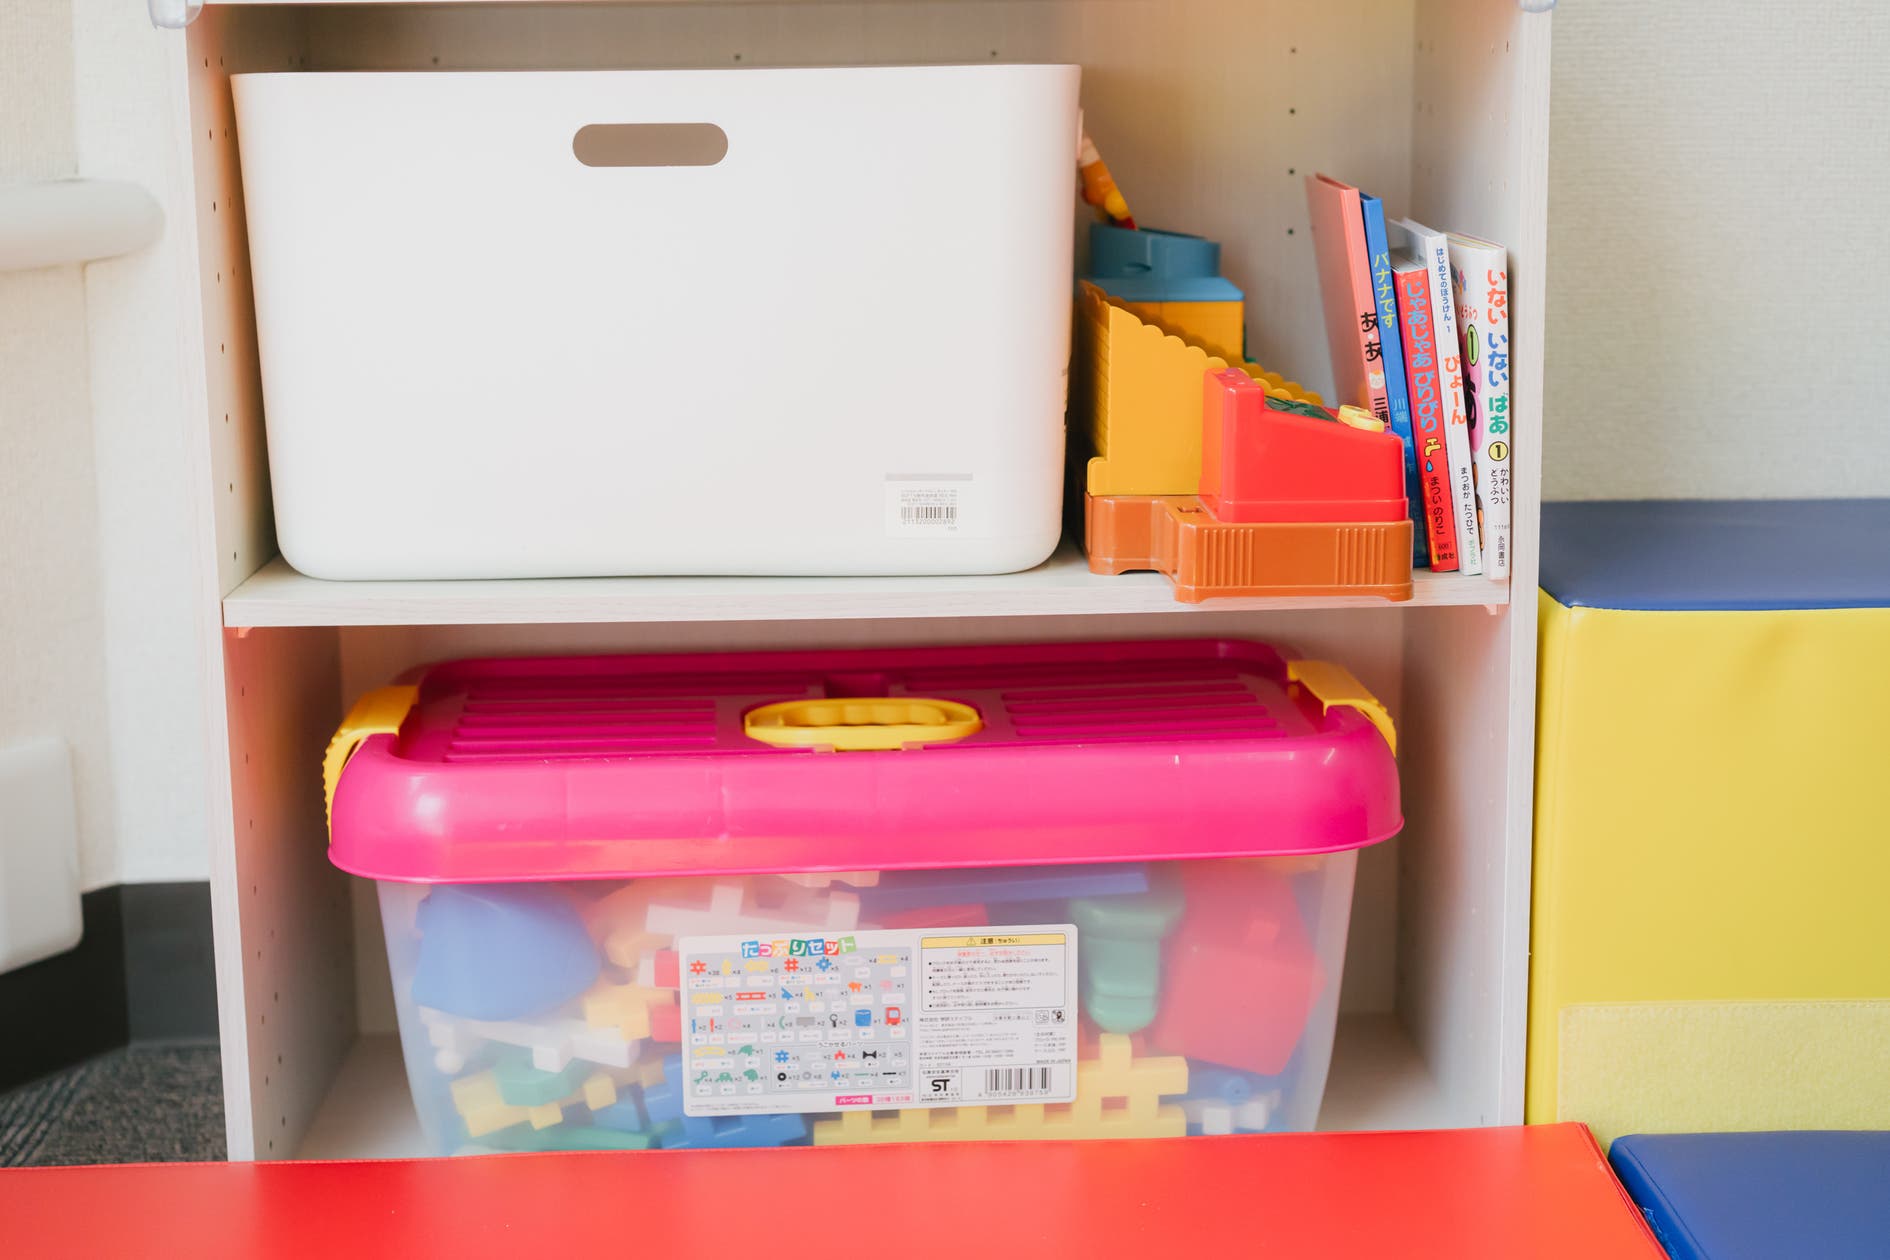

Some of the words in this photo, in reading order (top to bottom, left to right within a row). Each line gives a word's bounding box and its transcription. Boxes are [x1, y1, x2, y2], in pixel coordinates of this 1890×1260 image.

[1374, 252, 1396, 329] バナナです
[1487, 269, 1508, 325] いない
[1406, 282, 1432, 367] じゃあじゃあ
[1488, 332, 1508, 387] いない
[1414, 370, 1438, 432] びりびり
[1444, 354, 1466, 426] ぴょーん
[1489, 392, 1508, 434] ばあ
[1430, 476, 1442, 504] まつい
[1460, 467, 1470, 499] まつおか
[1500, 469, 1509, 504] かわいい
[1433, 507, 1446, 535] のりこ
[742, 936, 857, 958] たっぷりセット
[931, 1079, 951, 1092] ST
